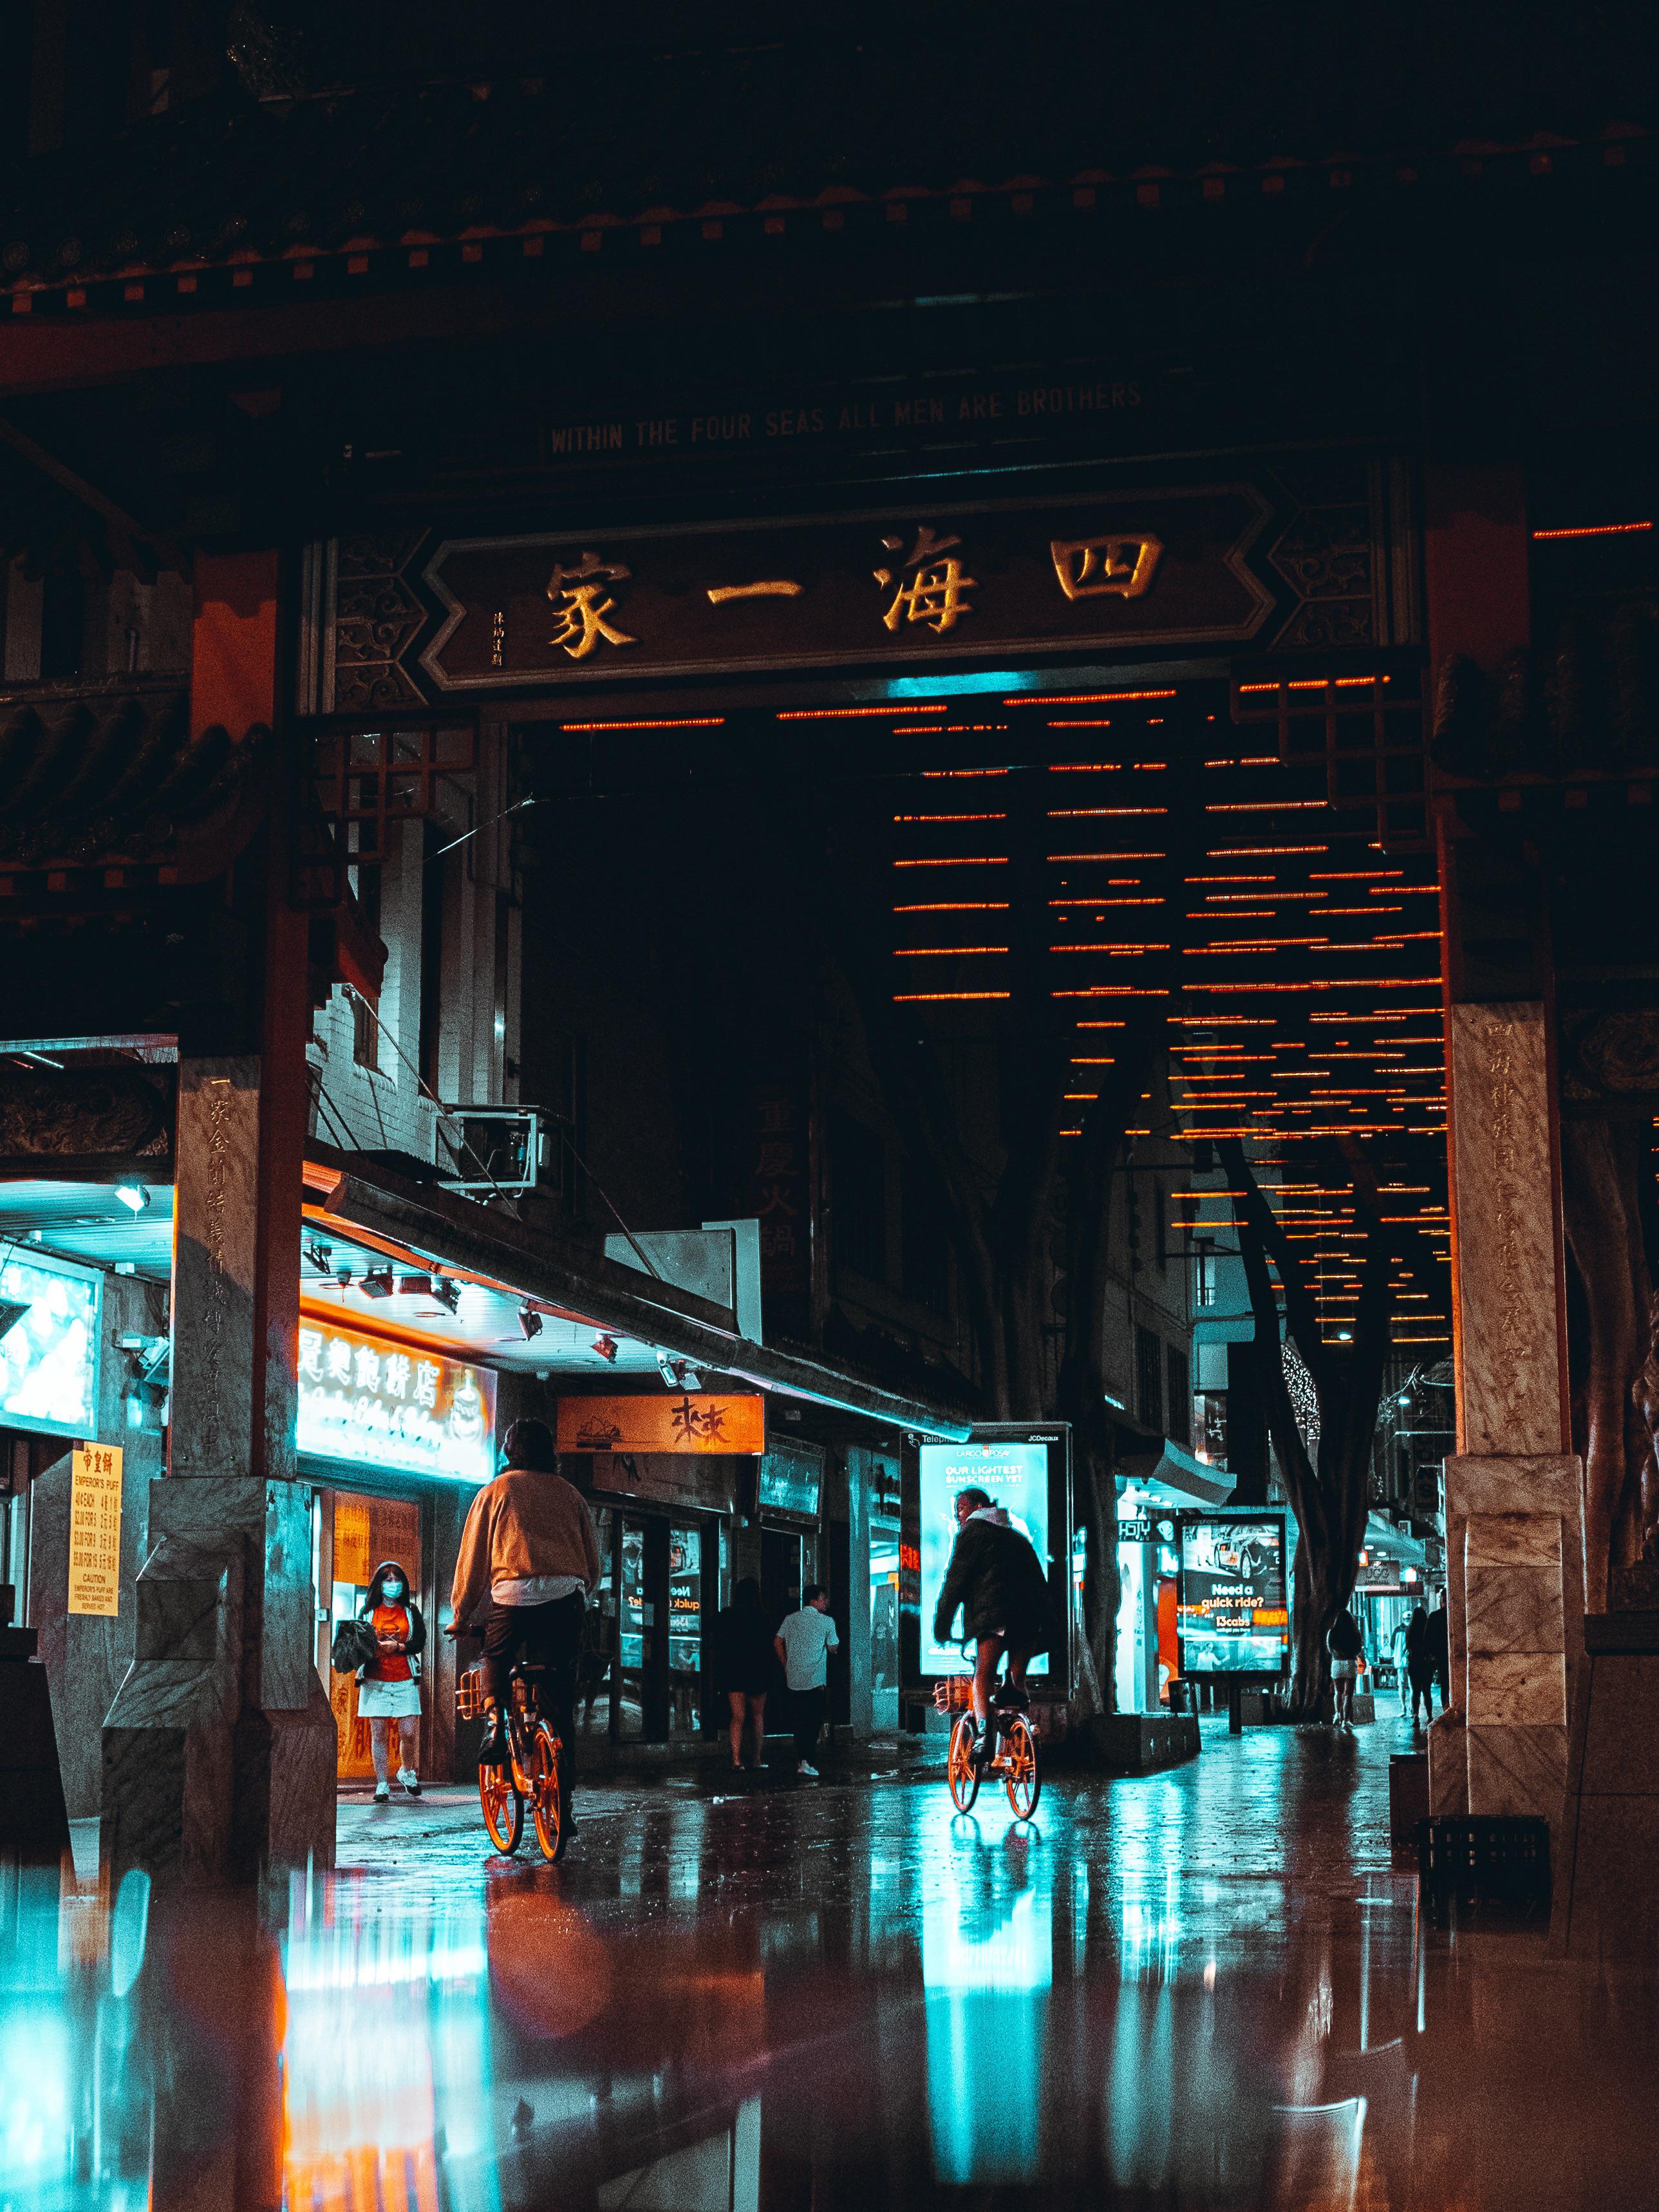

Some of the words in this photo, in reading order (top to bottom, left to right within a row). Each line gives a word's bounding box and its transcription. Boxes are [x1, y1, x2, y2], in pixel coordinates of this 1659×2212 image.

[552, 423, 622, 455] WITHIN
[635, 418, 677, 447] THE
[691, 413, 751, 442] FOUR
[765, 408, 825, 437] SEAS
[839, 400, 881, 430] ALL
[895, 397, 944, 426] MEN
[959, 391, 1003, 420] ARE
[1017, 381, 1143, 416] BROTHERS
[946, 1465, 969, 1474] OUR
[971, 1465, 1023, 1474] LIGHTEST
[75, 1475, 104, 1489] EMPEROR'S
[106, 1480, 119, 1491] PUFF
[946, 1475, 1004, 1483] SUNSCREEN
[1005, 1474, 1022, 1483] YET
[82, 1573, 106, 1584] CAUTION
[1212, 1584, 1244, 1595] Need
[1244, 1586, 1253, 1595] a
[1201, 1597, 1233, 1609] quick
[1235, 1596, 1264, 1607] ride?
[1216, 1616, 1250, 1627] 13cabs
